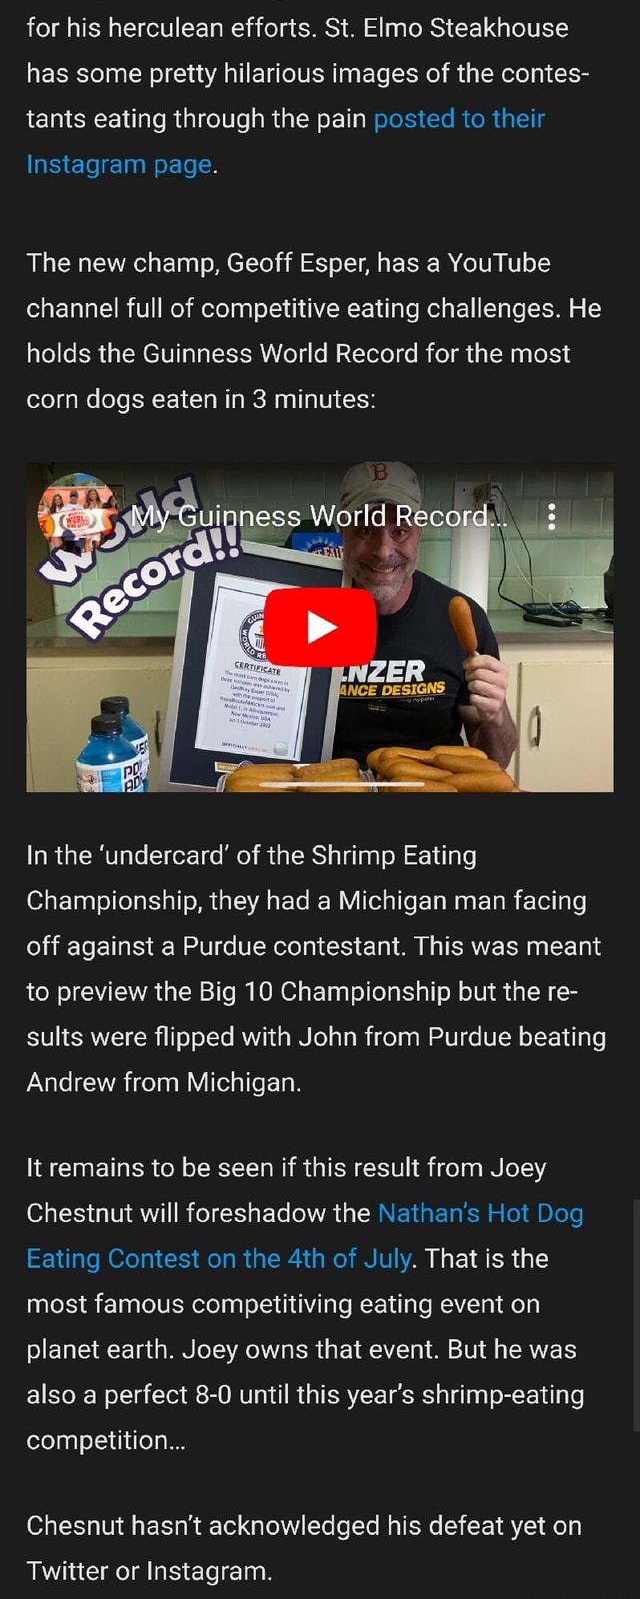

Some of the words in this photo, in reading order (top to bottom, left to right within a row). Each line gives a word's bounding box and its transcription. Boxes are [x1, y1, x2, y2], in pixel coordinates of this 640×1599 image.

[27, 153, 147, 180] Instagram
[154, 158, 218, 180] page.
[234, 661, 281, 676] CERTIFICATE
[381, 680, 447, 696] DESIGNS
[26, 934, 61, 957] off
[67, 935, 155, 962] against
[161, 940, 175, 957] a
[183, 934, 267, 957] Purdue
[273, 936, 406, 957] contestant.
[413, 934, 464, 957] This
[470, 940, 519, 957] was
[526, 936, 602, 957] meant
[27, 1247, 101, 1274] Eating
[108, 1247, 200, 1269] Contest
[207, 1252, 237, 1269] on
[242, 1246, 281, 1269] the
[287, 1246, 325, 1269] 4th
[332, 1246, 358, 1269] of
[363, 1246, 417, 1274] July.
[424, 1246, 478, 1269] That
[485, 1247, 505, 1269] is
[510, 1246, 549, 1269] the
[25, 1560, 110, 1582] Twitter
[115, 1564, 141, 1582] or
[147, 1560, 273, 1587] Instagram.
